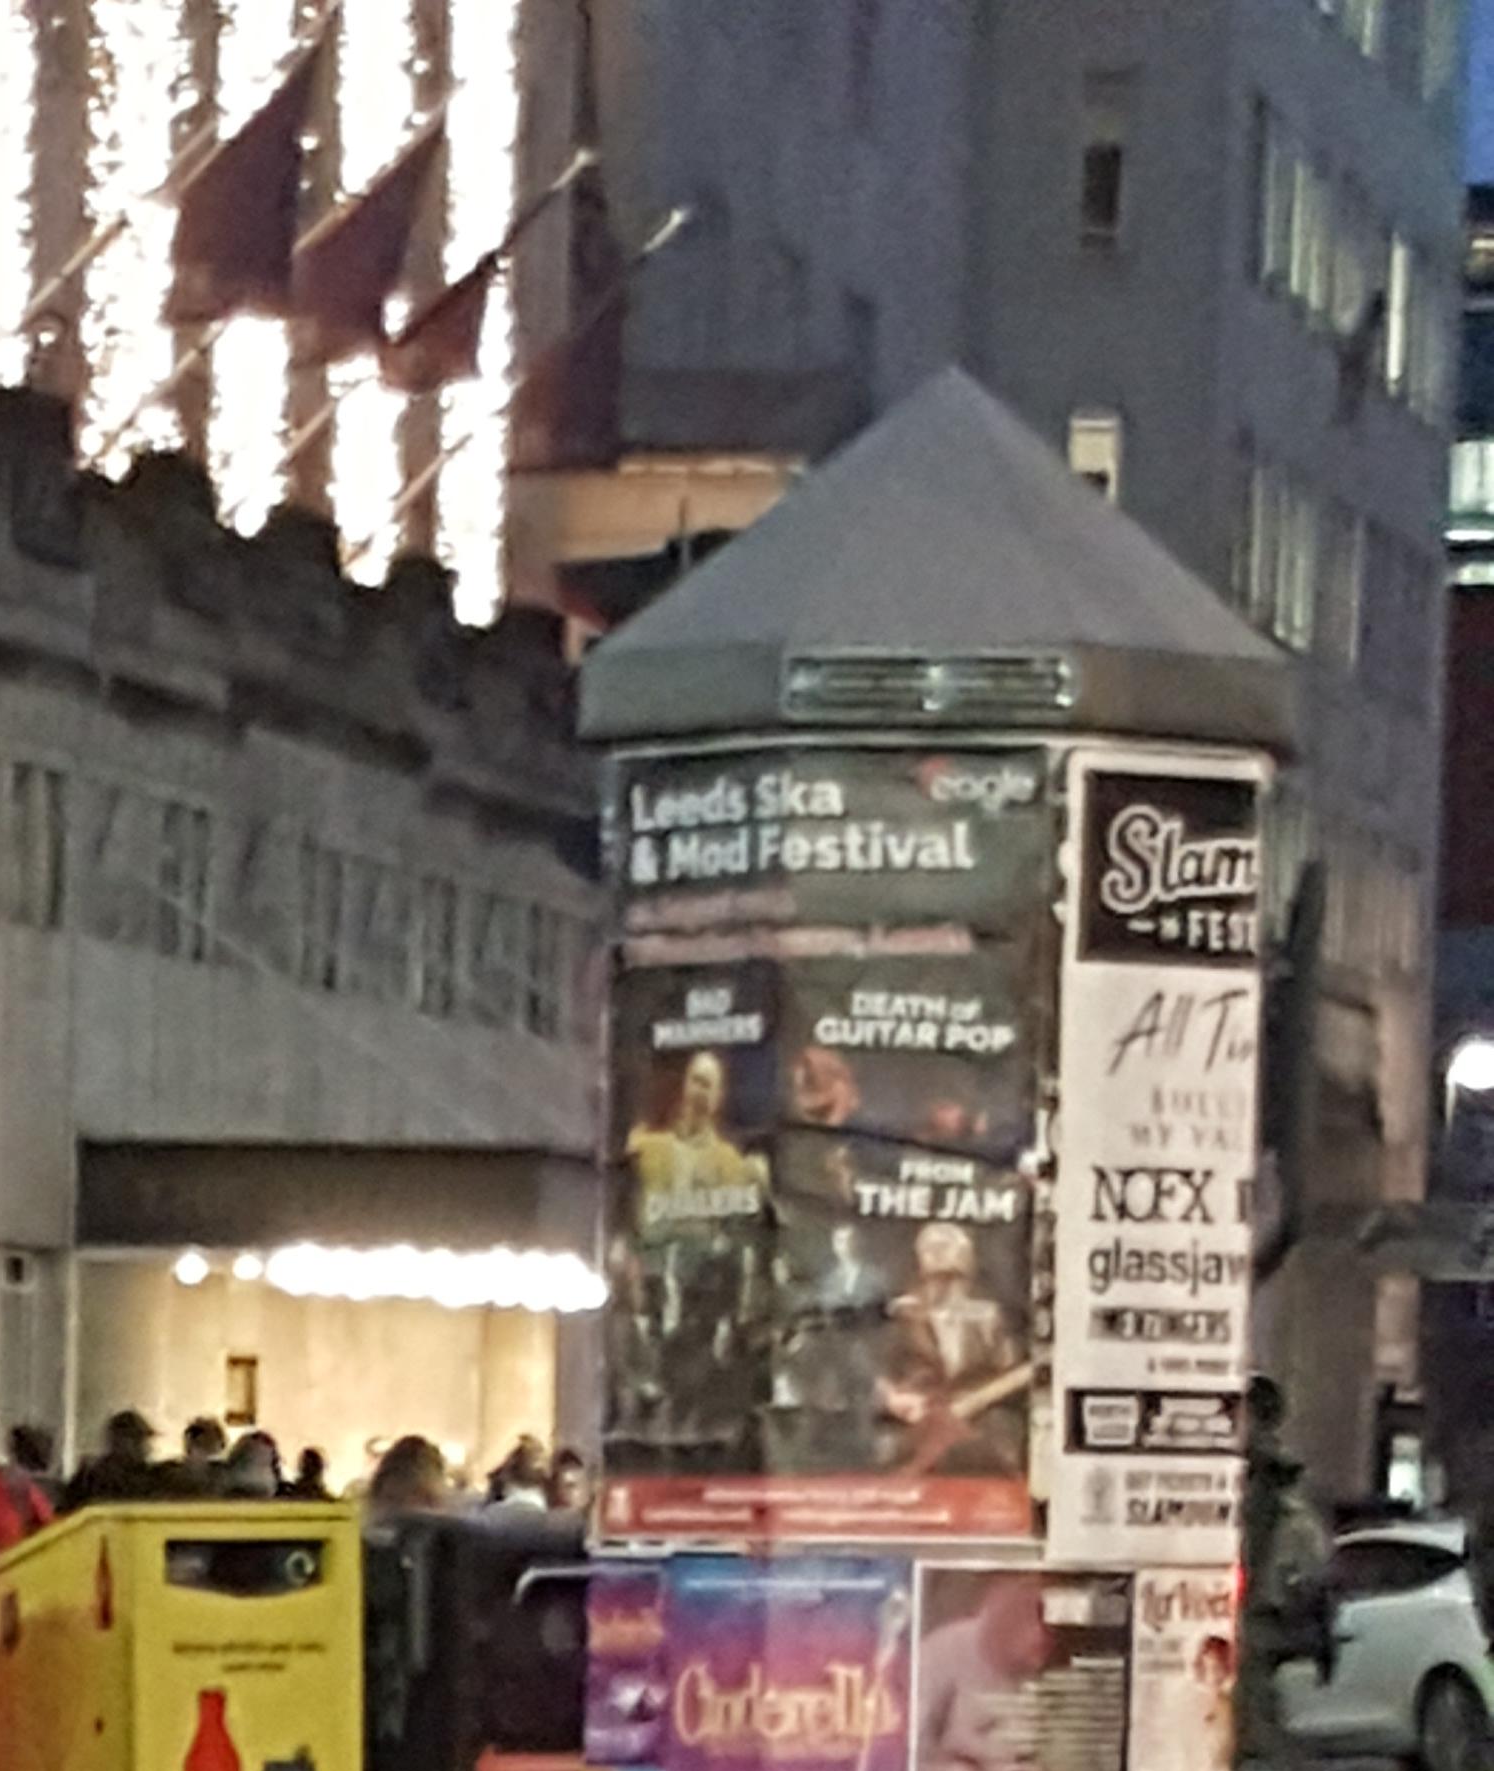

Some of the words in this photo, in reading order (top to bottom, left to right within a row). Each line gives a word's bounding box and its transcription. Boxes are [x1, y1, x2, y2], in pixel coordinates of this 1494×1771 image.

[631, 774, 748, 832] Leeds
[754, 769, 846, 818] Ska
[665, 826, 750, 881] Mod
[757, 821, 976, 871] Festival
[1102, 804, 1257, 914] Slam
[851, 991, 946, 1019] DEATH
[814, 1017, 931, 1048] GUITAR
[944, 1019, 1017, 1052] POP
[900, 1160, 976, 1185] FROM
[1090, 1165, 1214, 1224] NOFX
[853, 1182, 932, 1217] THE
[937, 1187, 1017, 1222] JAM
